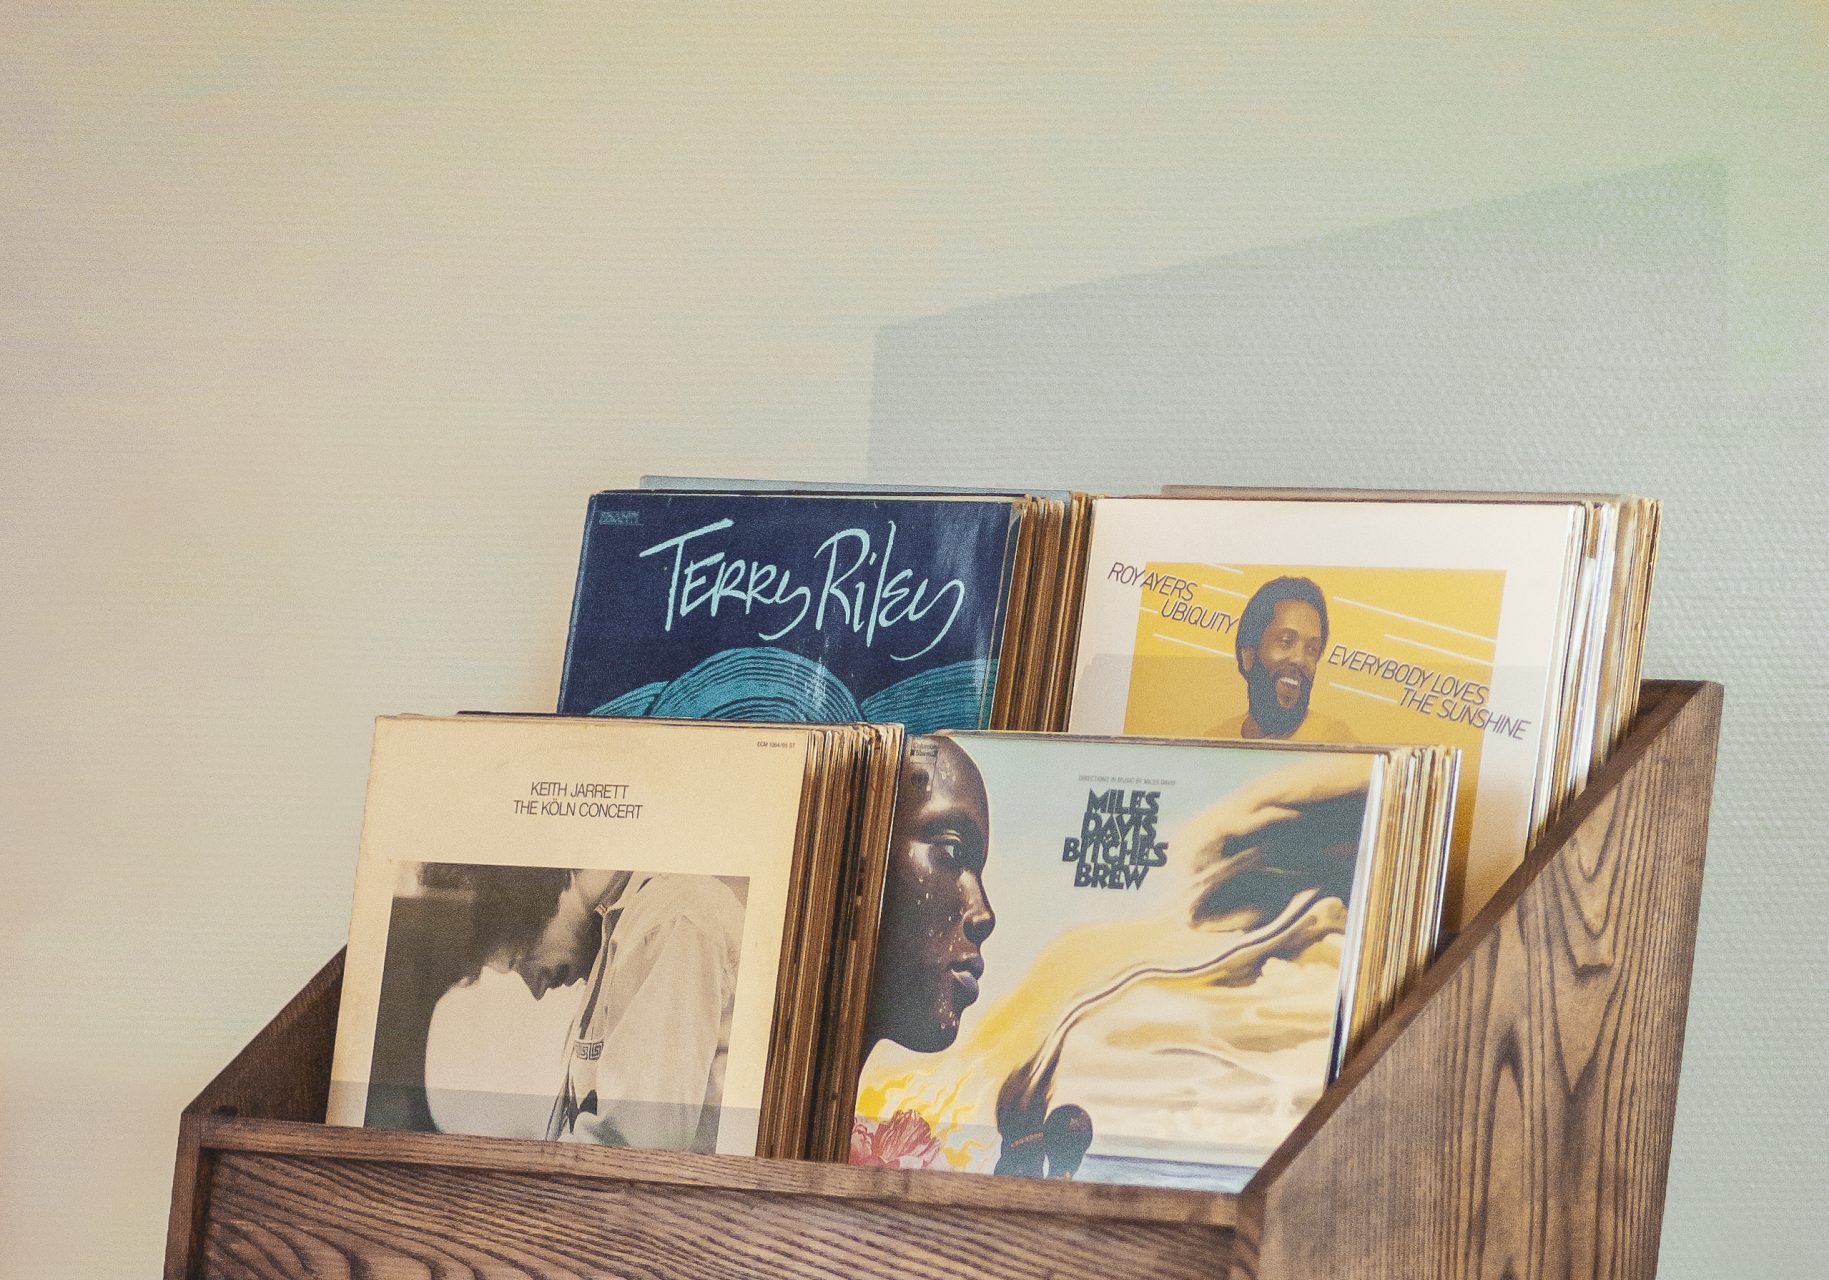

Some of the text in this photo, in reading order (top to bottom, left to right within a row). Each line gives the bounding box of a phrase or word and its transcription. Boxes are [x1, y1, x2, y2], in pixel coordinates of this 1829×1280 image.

[1107, 561, 1198, 602] ROY AYERS
[1161, 598, 1240, 634] UBIQUITY
[1327, 644, 1490, 706] EVERYBODY LOVES
[1400, 687, 1532, 741] THE SUNSHINE
[530, 781, 630, 800] KEITH JARRETT
[1086, 787, 1161, 814] MILES
[514, 797, 644, 820] THE KÖLN CONCERT
[1081, 811, 1158, 842] DAVIS
[1062, 837, 1169, 867] BITCHES
[1074, 863, 1150, 890] BREW
